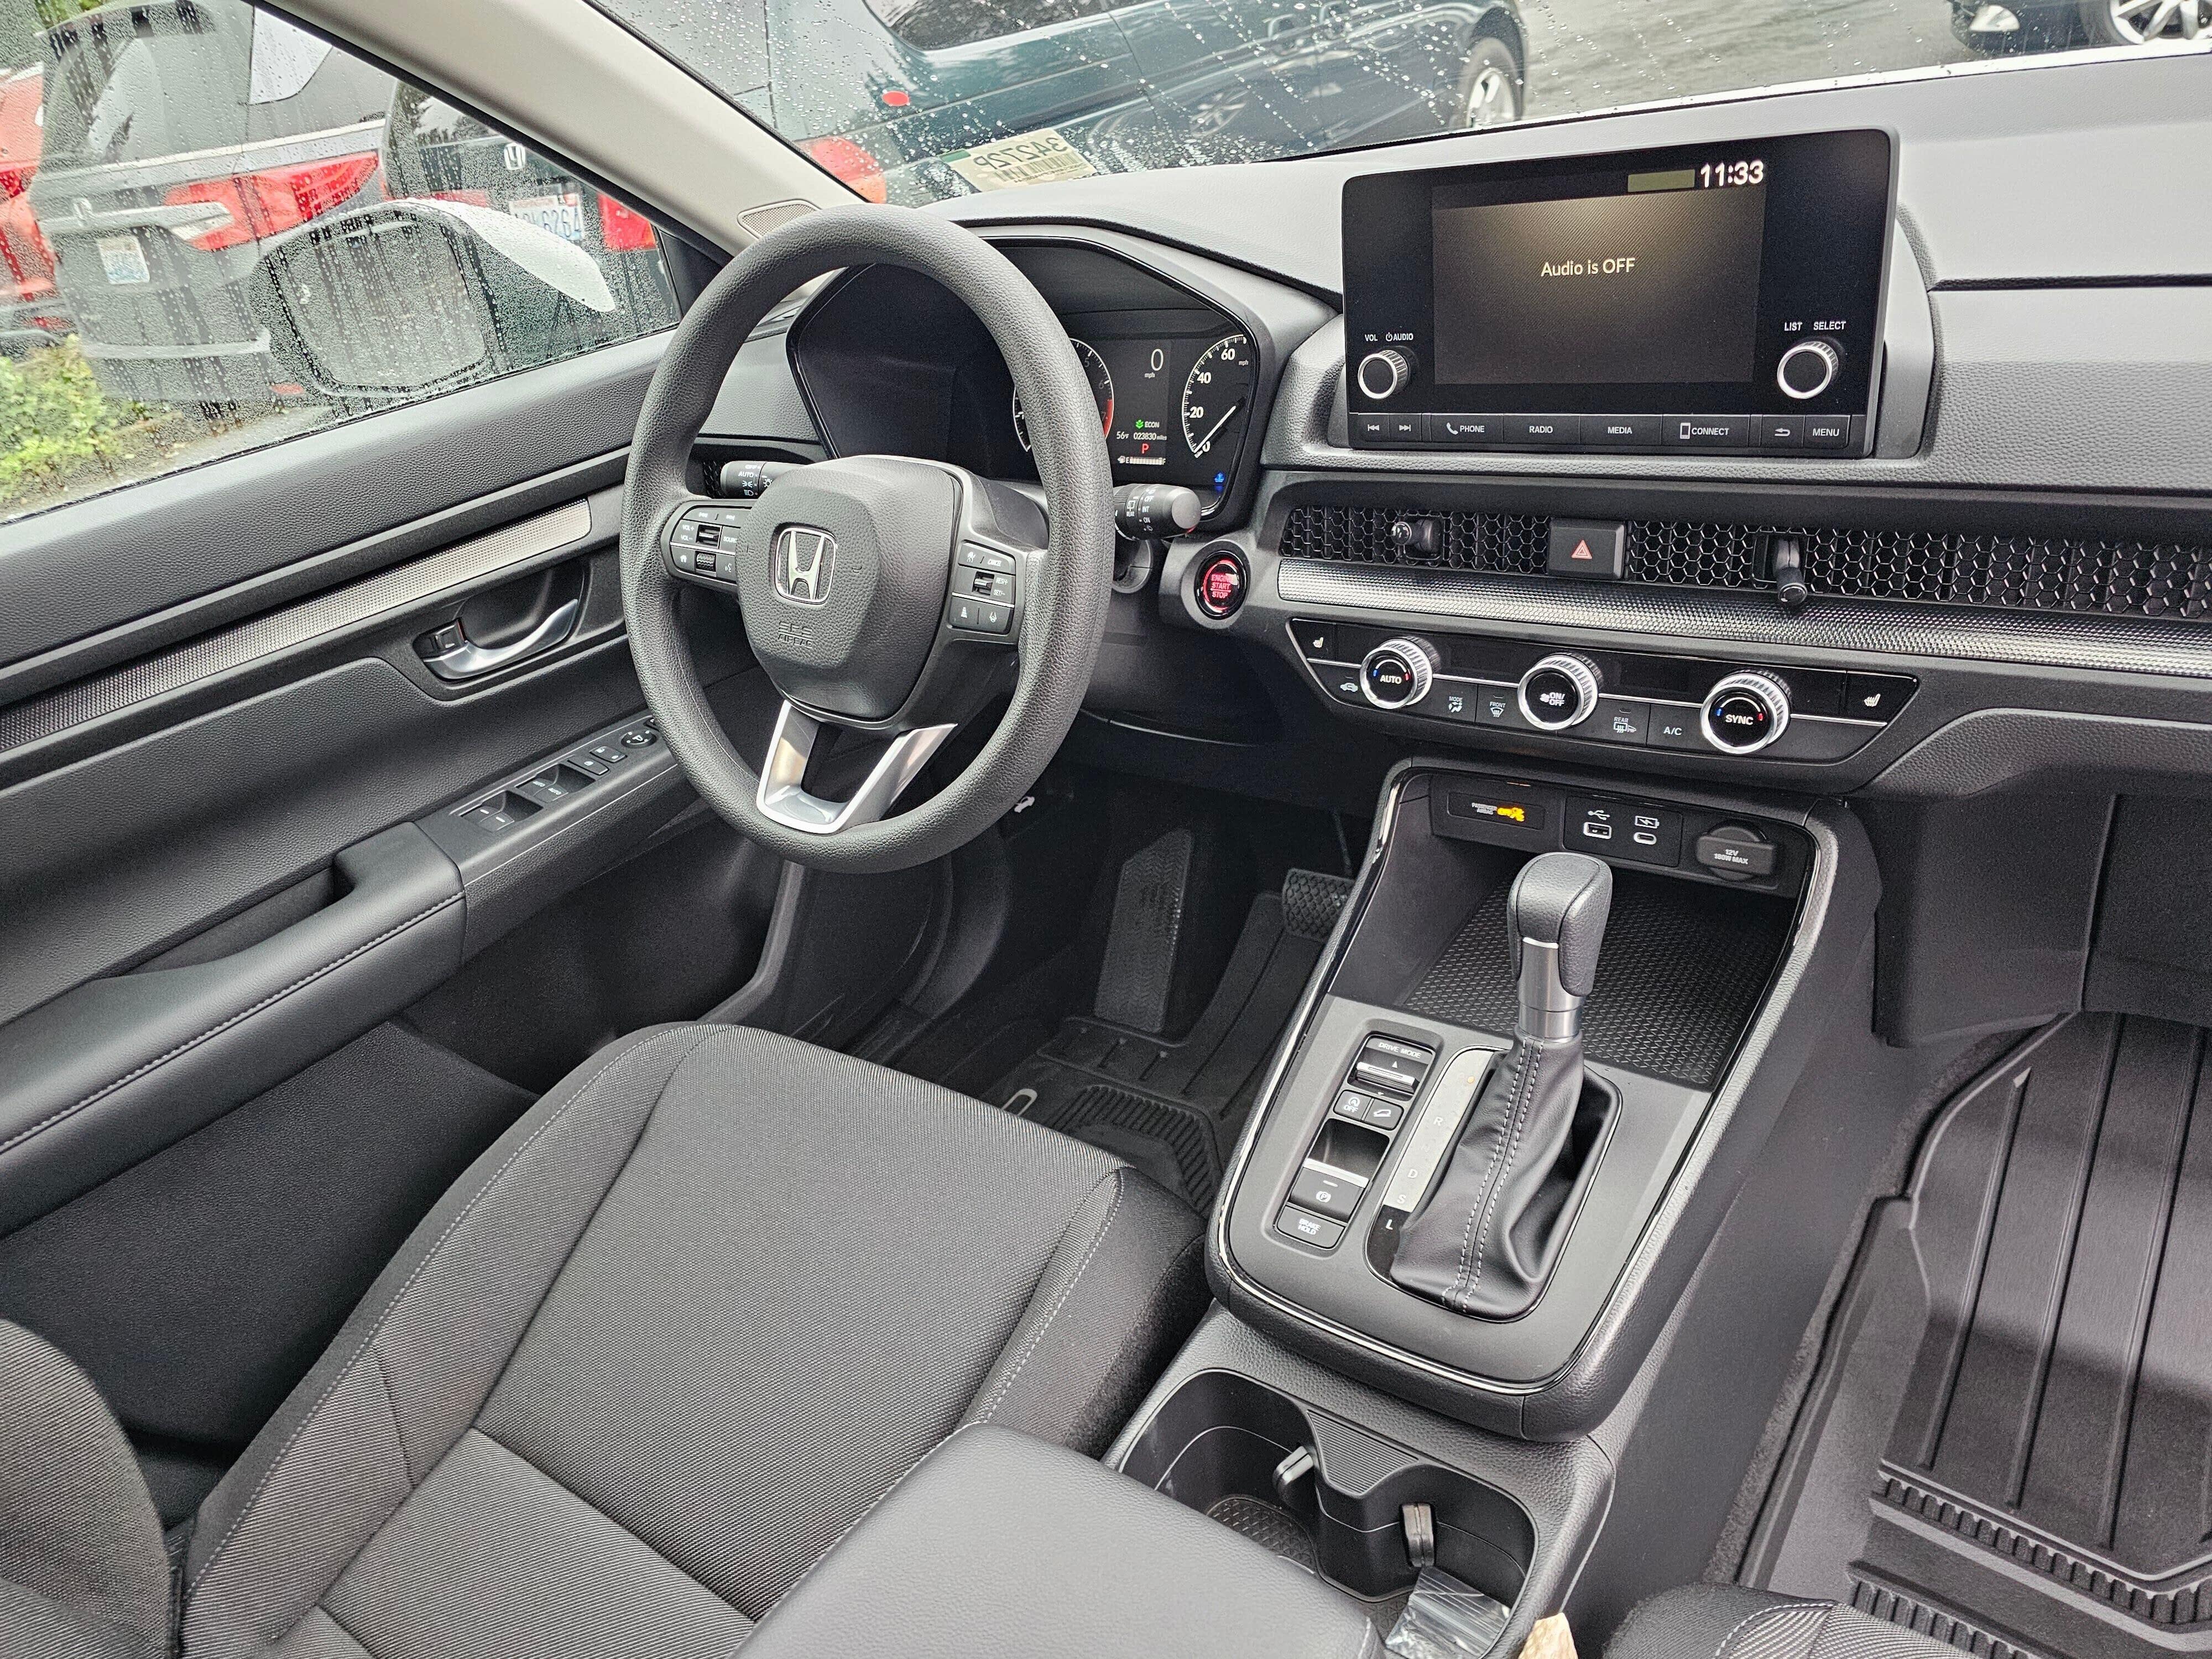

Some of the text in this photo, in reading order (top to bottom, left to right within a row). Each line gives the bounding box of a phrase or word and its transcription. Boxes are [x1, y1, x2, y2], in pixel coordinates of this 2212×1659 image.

[1700, 159, 1765, 188] 11:33
[1541, 257, 1636, 276] Audio is OFF
[1784, 321, 1846, 331] LIST SELECT
[1151, 348, 1164, 371] 0
[1220, 348, 1236, 361] 60
[1084, 357, 1090, 368] 5
[1197, 372, 1212, 384] 40
[1189, 406, 1204, 418] 20
[1529, 425, 1553, 434] RADIO
[1691, 427, 1729, 436] CONNECT
[1812, 428, 1840, 436] MENU
[1141, 444, 1150, 454] P
[1202, 441, 1211, 452] 0
[1212, 582, 1232, 590] START
[1379, 674, 1402, 685] AUTO
[1725, 714, 1754, 726] SYNC
[1663, 726, 1682, 735] A/C
[1378, 1042, 1422, 1059] DRIVE MODE
[1433, 1117, 1443, 1126] R
[1407, 1168, 1418, 1178] D
[1397, 1194, 1407, 1204] S
[1385, 1219, 1394, 1230] L
